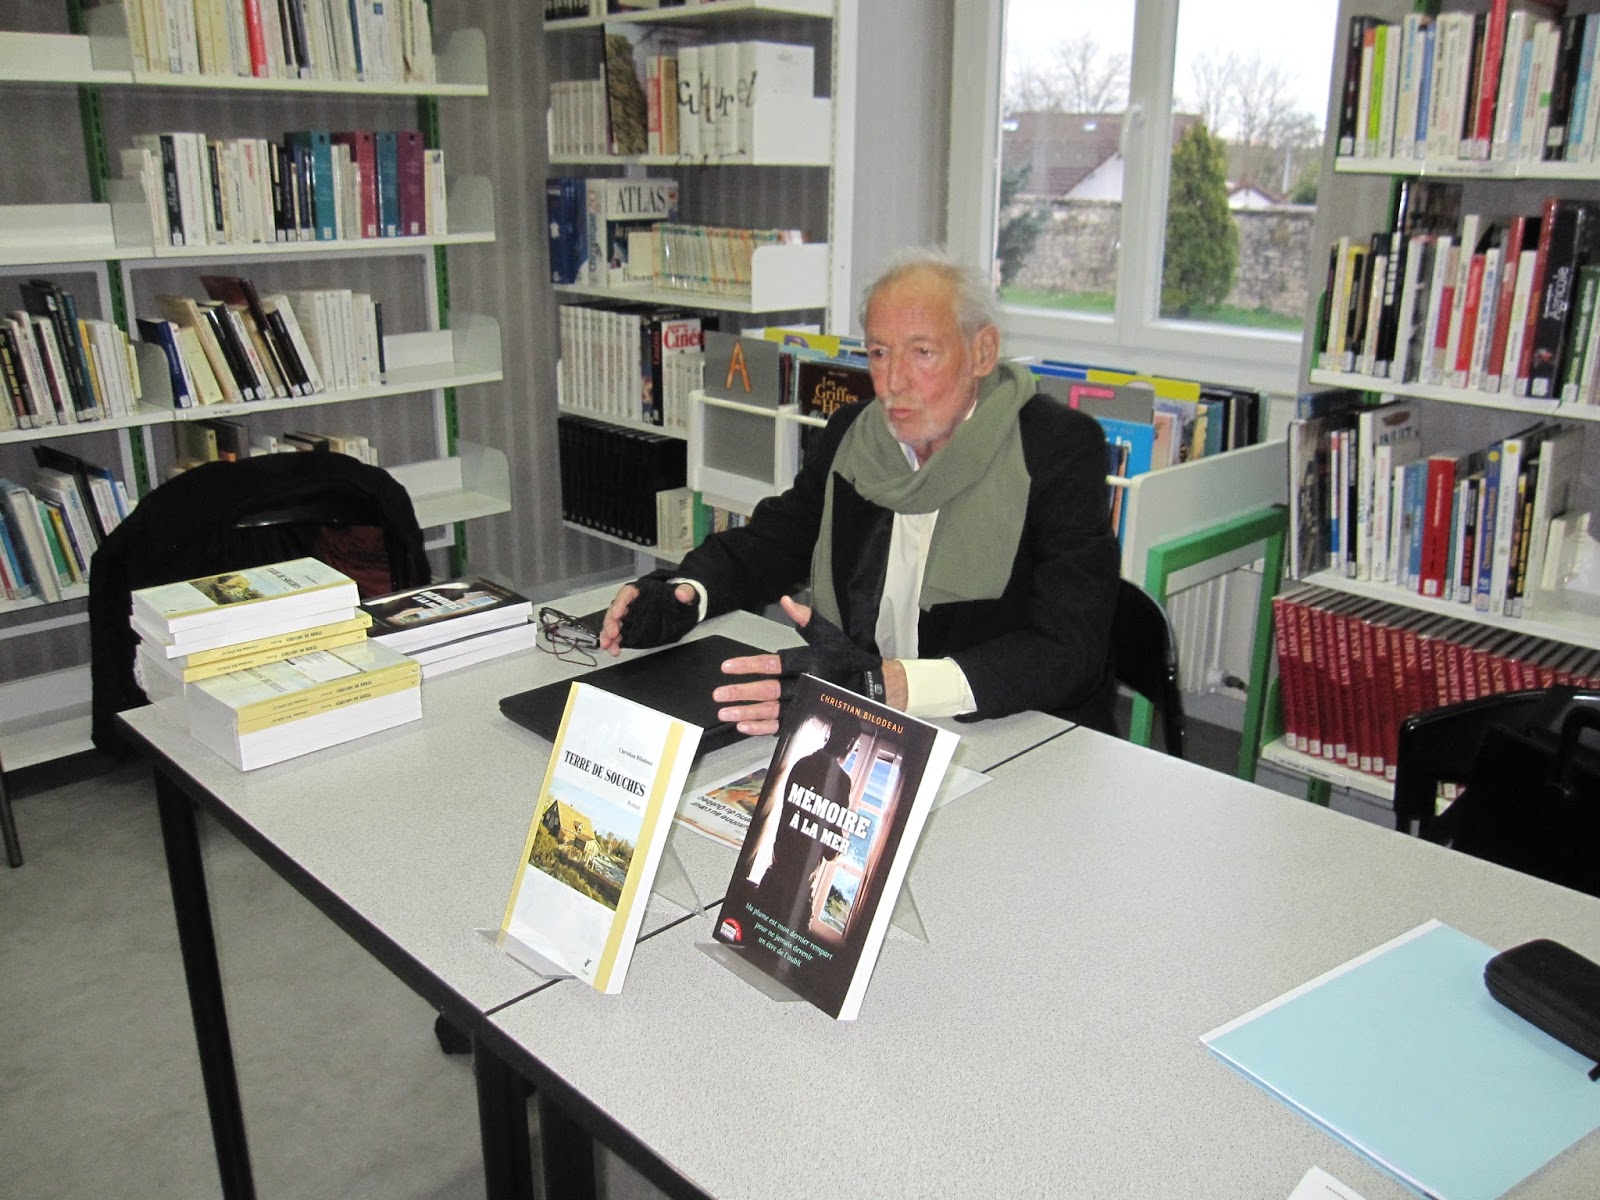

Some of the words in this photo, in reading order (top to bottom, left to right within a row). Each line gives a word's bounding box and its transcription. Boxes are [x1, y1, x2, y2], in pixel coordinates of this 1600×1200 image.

[615, 186, 666, 212] ATLAS
[725, 340, 752, 393] A
[816, 384, 858, 404] Griffes
[1286, 606, 1299, 656] LIMOUSIN
[1300, 609, 1312, 663] BRETAGNE
[1336, 617, 1350, 685] L'AUTOMOBILE
[1350, 620, 1361, 660] ALSACE
[1376, 628, 1388, 657] PARIS
[1404, 634, 1416, 668] NORD
[1420, 639, 1432, 670] LYON
[1435, 644, 1448, 706] BOURGOGNE
[820, 693, 861, 717] CHRISTIAN
[862, 711, 904, 734] BILODEAU
[564, 750, 592, 772] TERRE
[592, 763, 604, 778] DE
[604, 769, 646, 797] SOUCHES
[618, 747, 636, 760] Christian
[636, 754, 653, 766] Bilodeau
[627, 800, 640, 810] Roman
[697, 796, 725, 810] Québec
[787, 782, 872, 840] MÉMOIRE
[789, 810, 801, 830] À
[800, 822, 819, 839] LA
[820, 829, 850, 856] MER
[745, 902, 753, 912] Ma
[752, 908, 769, 921] plume
[769, 919, 777, 927] est
[777, 924, 789, 933] mon
[789, 930, 809, 946] dernier
[810, 942, 833, 960] rempart
[754, 922, 768, 933] pour
[774, 933, 792, 949] jamais
[792, 944, 813, 961] devenir
[758, 936, 767, 945] un
[766, 940, 777, 952] être
[776, 948, 785, 958] de
